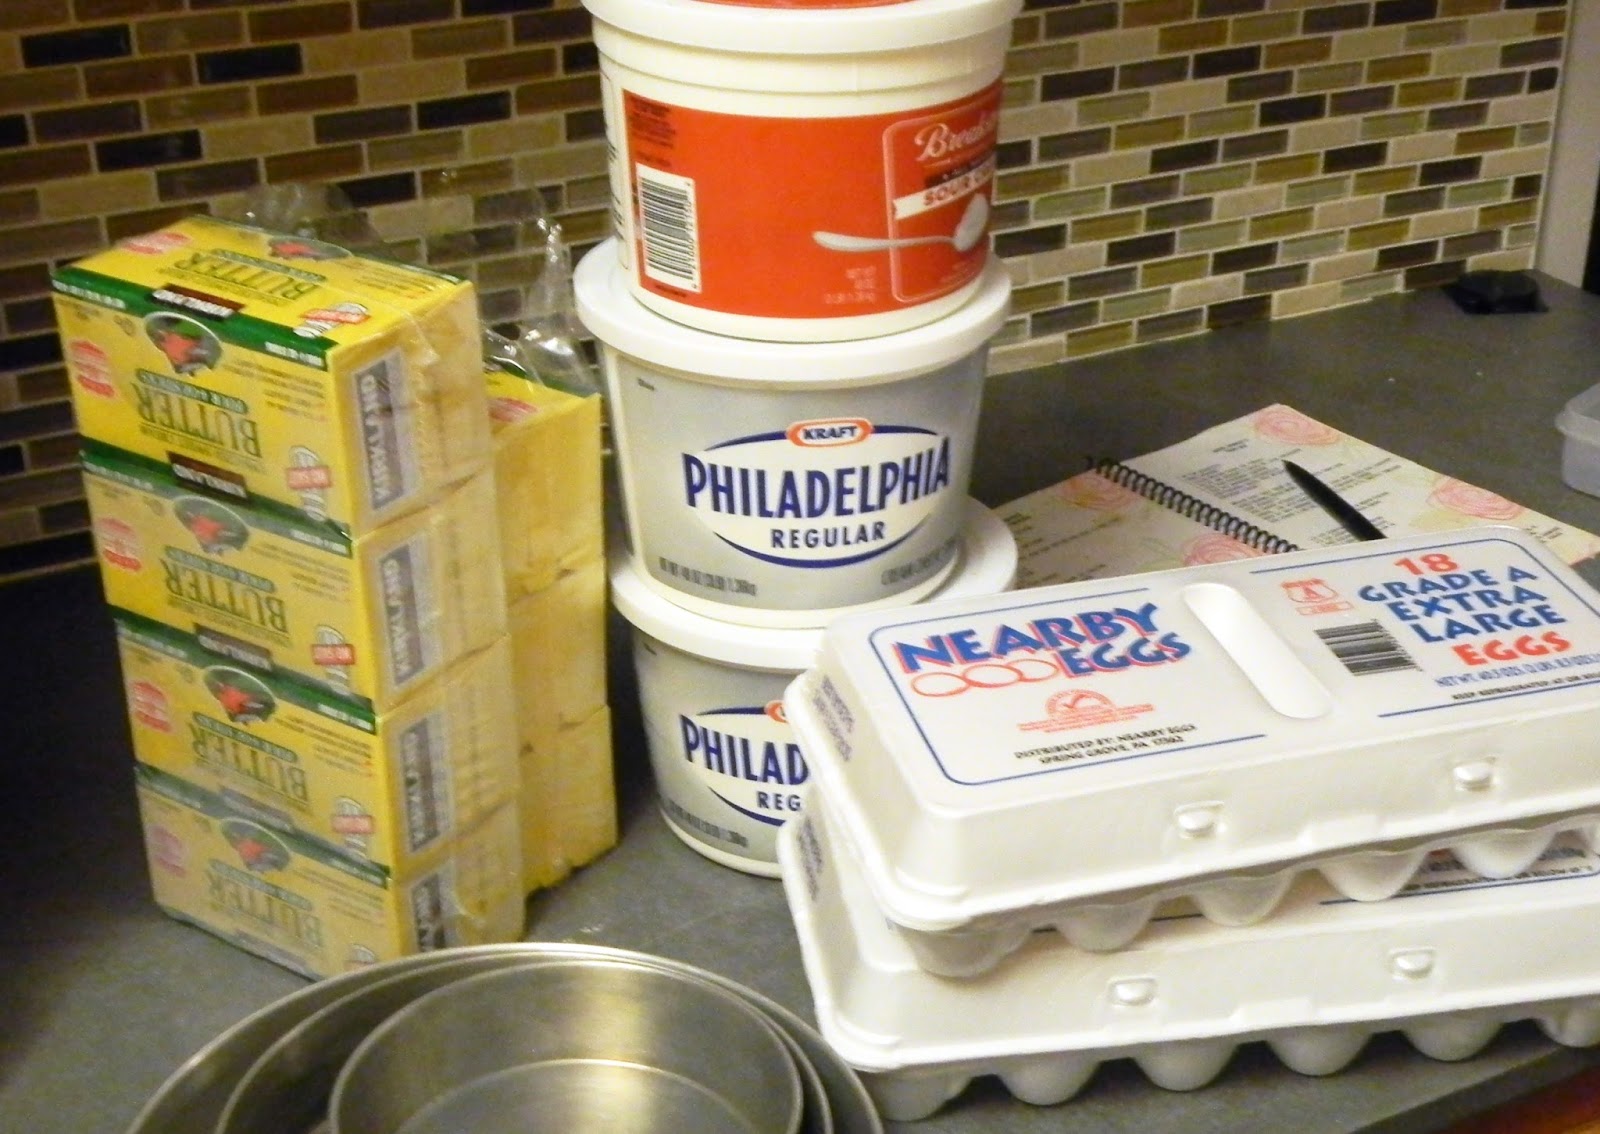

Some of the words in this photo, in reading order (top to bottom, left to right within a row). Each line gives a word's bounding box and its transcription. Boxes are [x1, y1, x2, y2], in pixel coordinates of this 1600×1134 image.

[132, 382, 262, 458] BUTTER
[801, 424, 858, 441] KRAFT
[682, 437, 951, 519] PHILADELPHIA
[771, 521, 886, 549] REGULAR
[1394, 552, 1459, 576] 18
[160, 560, 289, 634] BUTTER
[1358, 568, 1499, 602] GRADE
[1507, 565, 1539, 583] A
[1387, 585, 1548, 621] EXTRA
[893, 602, 1158, 673] NEARBY
[1408, 604, 1568, 643] LARGE
[1051, 631, 1192, 679] EGGS
[1452, 631, 1572, 666] EGGS
[188, 723, 308, 802] BUTTER
[680, 714, 809, 786] PHILAD
[1014, 740, 1093, 759] DISTRIBUTED
[1116, 728, 1165, 742] NEARBY
[1039, 751, 1084, 765] SPRING
